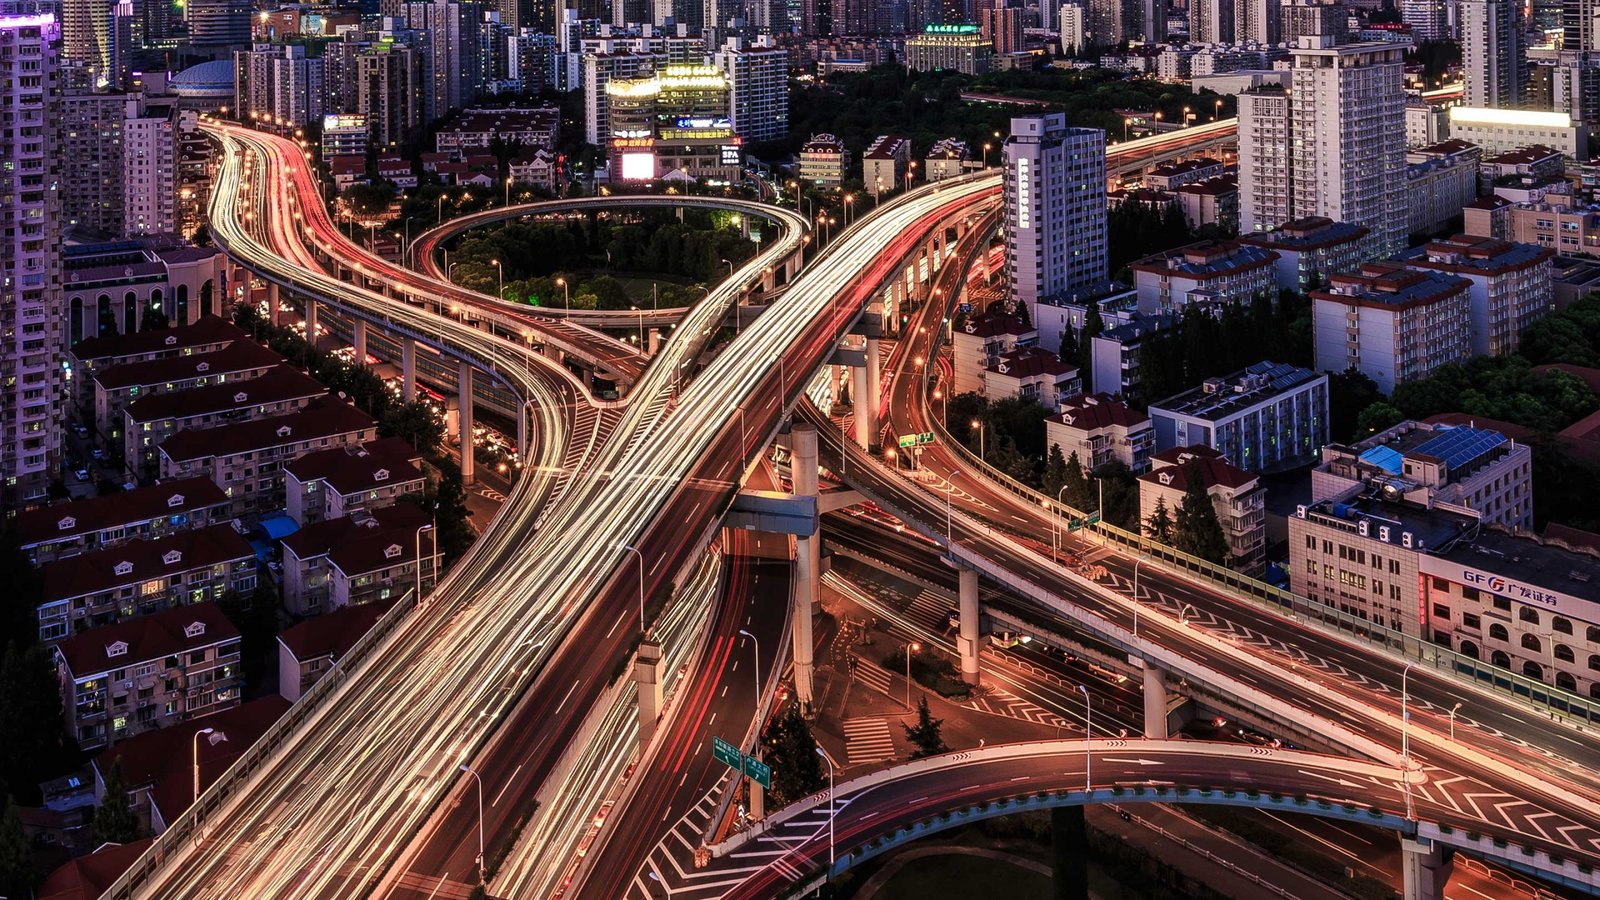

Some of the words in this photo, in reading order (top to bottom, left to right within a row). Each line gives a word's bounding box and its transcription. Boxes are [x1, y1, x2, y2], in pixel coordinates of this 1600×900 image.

[1464, 571, 1485, 583] GF
[1508, 584, 1557, 606] 广发证券
